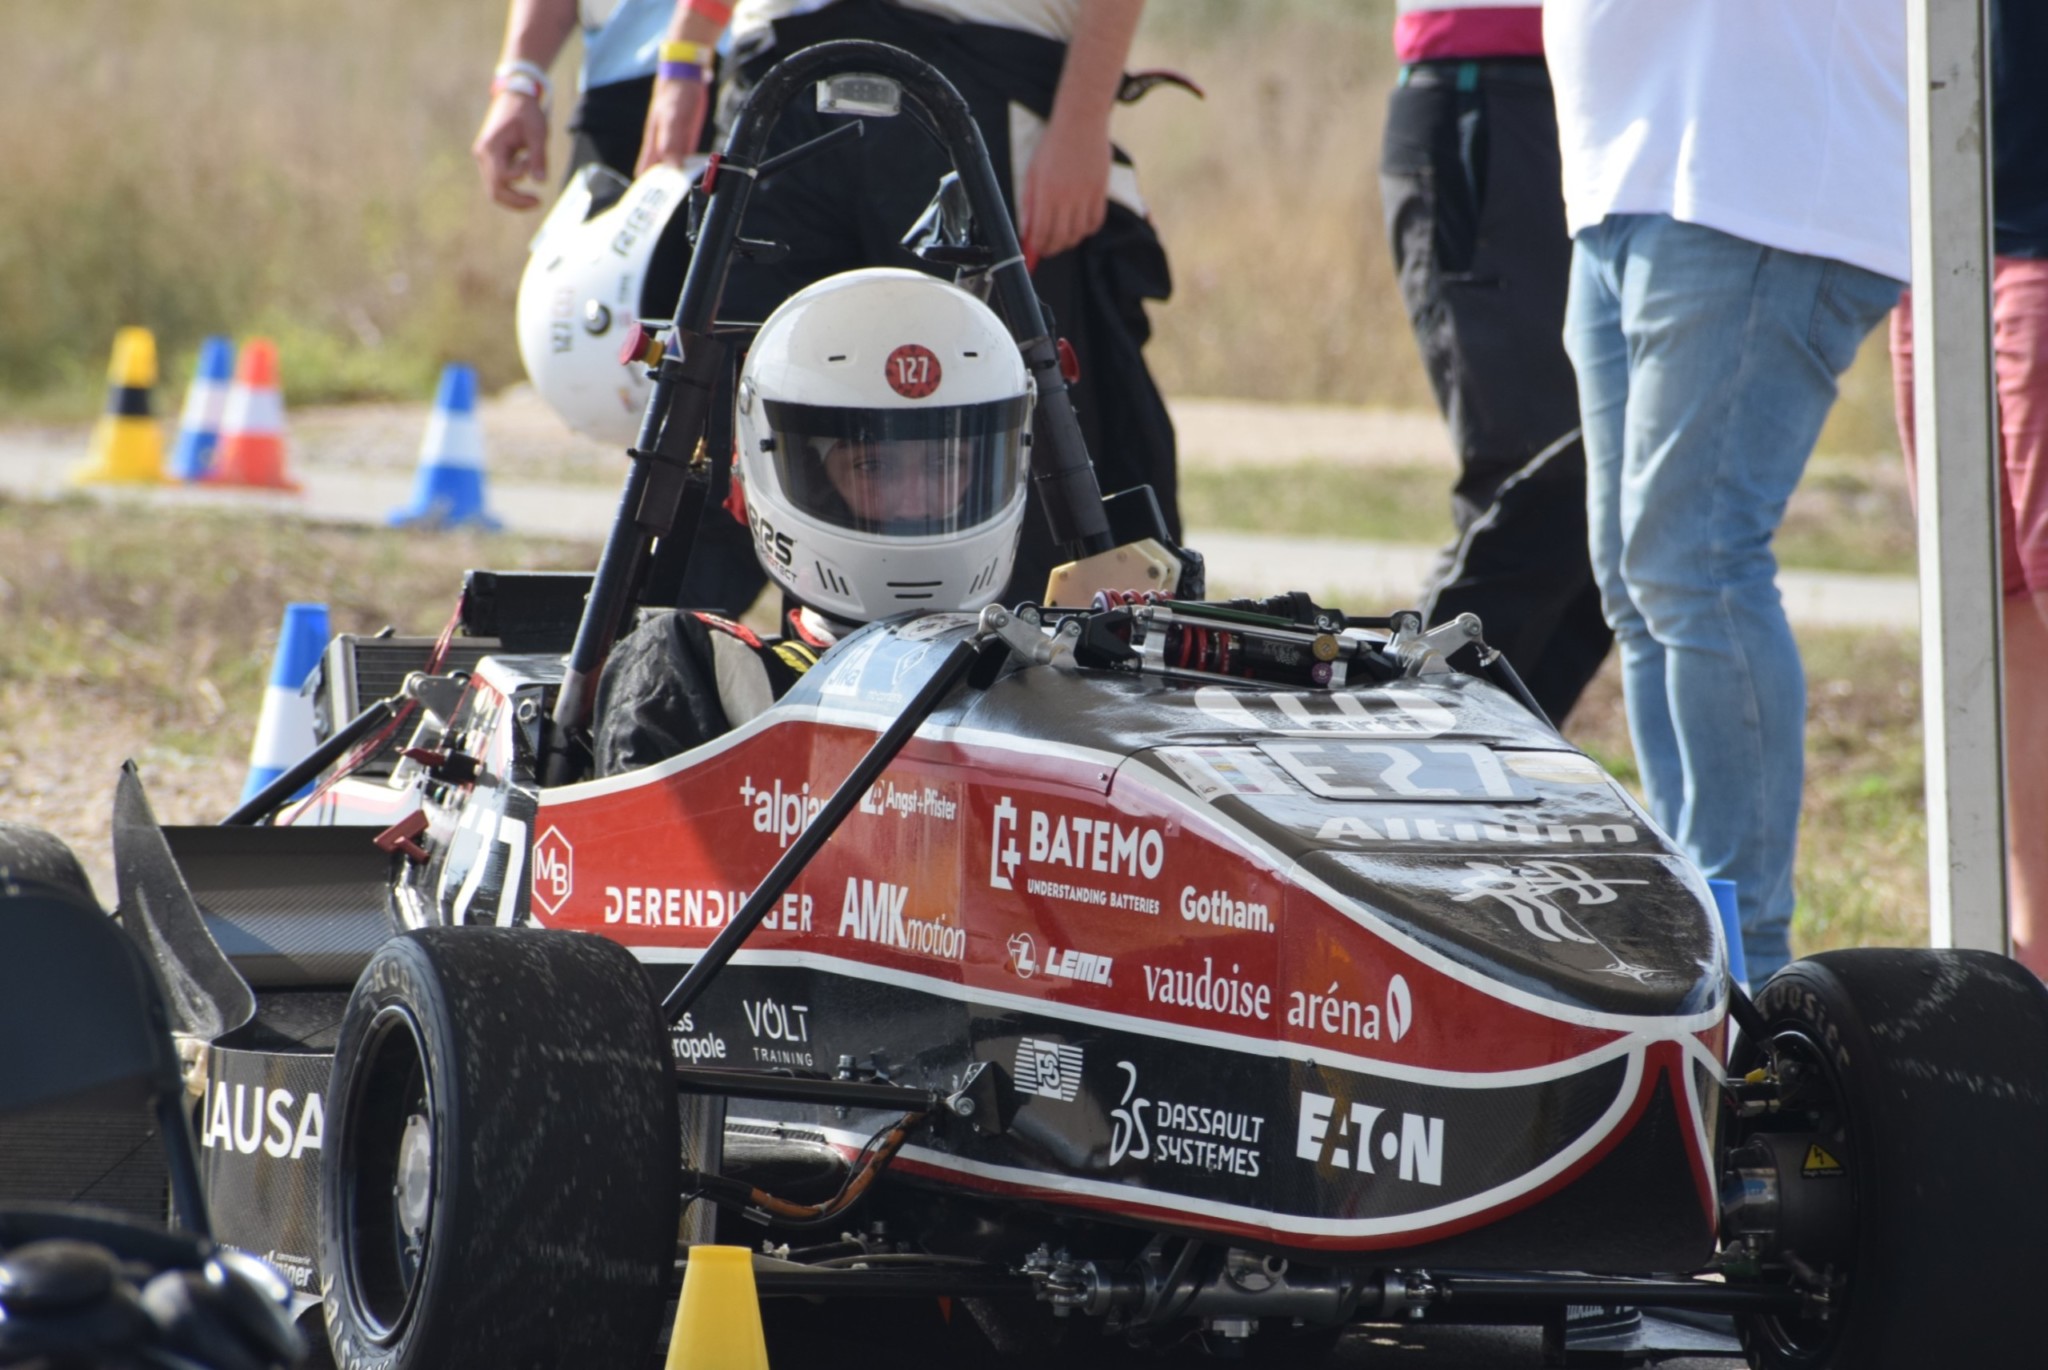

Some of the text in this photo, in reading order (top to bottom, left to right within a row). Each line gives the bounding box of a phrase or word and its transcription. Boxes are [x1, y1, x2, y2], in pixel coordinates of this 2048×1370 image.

[896, 356, 928, 384] 127
[1029, 810, 1164, 880] BATEMO
[1316, 814, 1638, 844] Altium
[1027, 878, 1160, 915] UNDERSTANDING BATTERIES
[1179, 885, 1275, 933] Gotham.
[743, 998, 808, 1042] VOLT
[1143, 957, 1381, 1041] vaudoise aréna
[672, 1032, 727, 1065] ropole
[753, 1047, 813, 1067] TRAINING
[1157, 1100, 1265, 1144] DASSAULT
[1296, 1090, 1445, 1186] EATON
